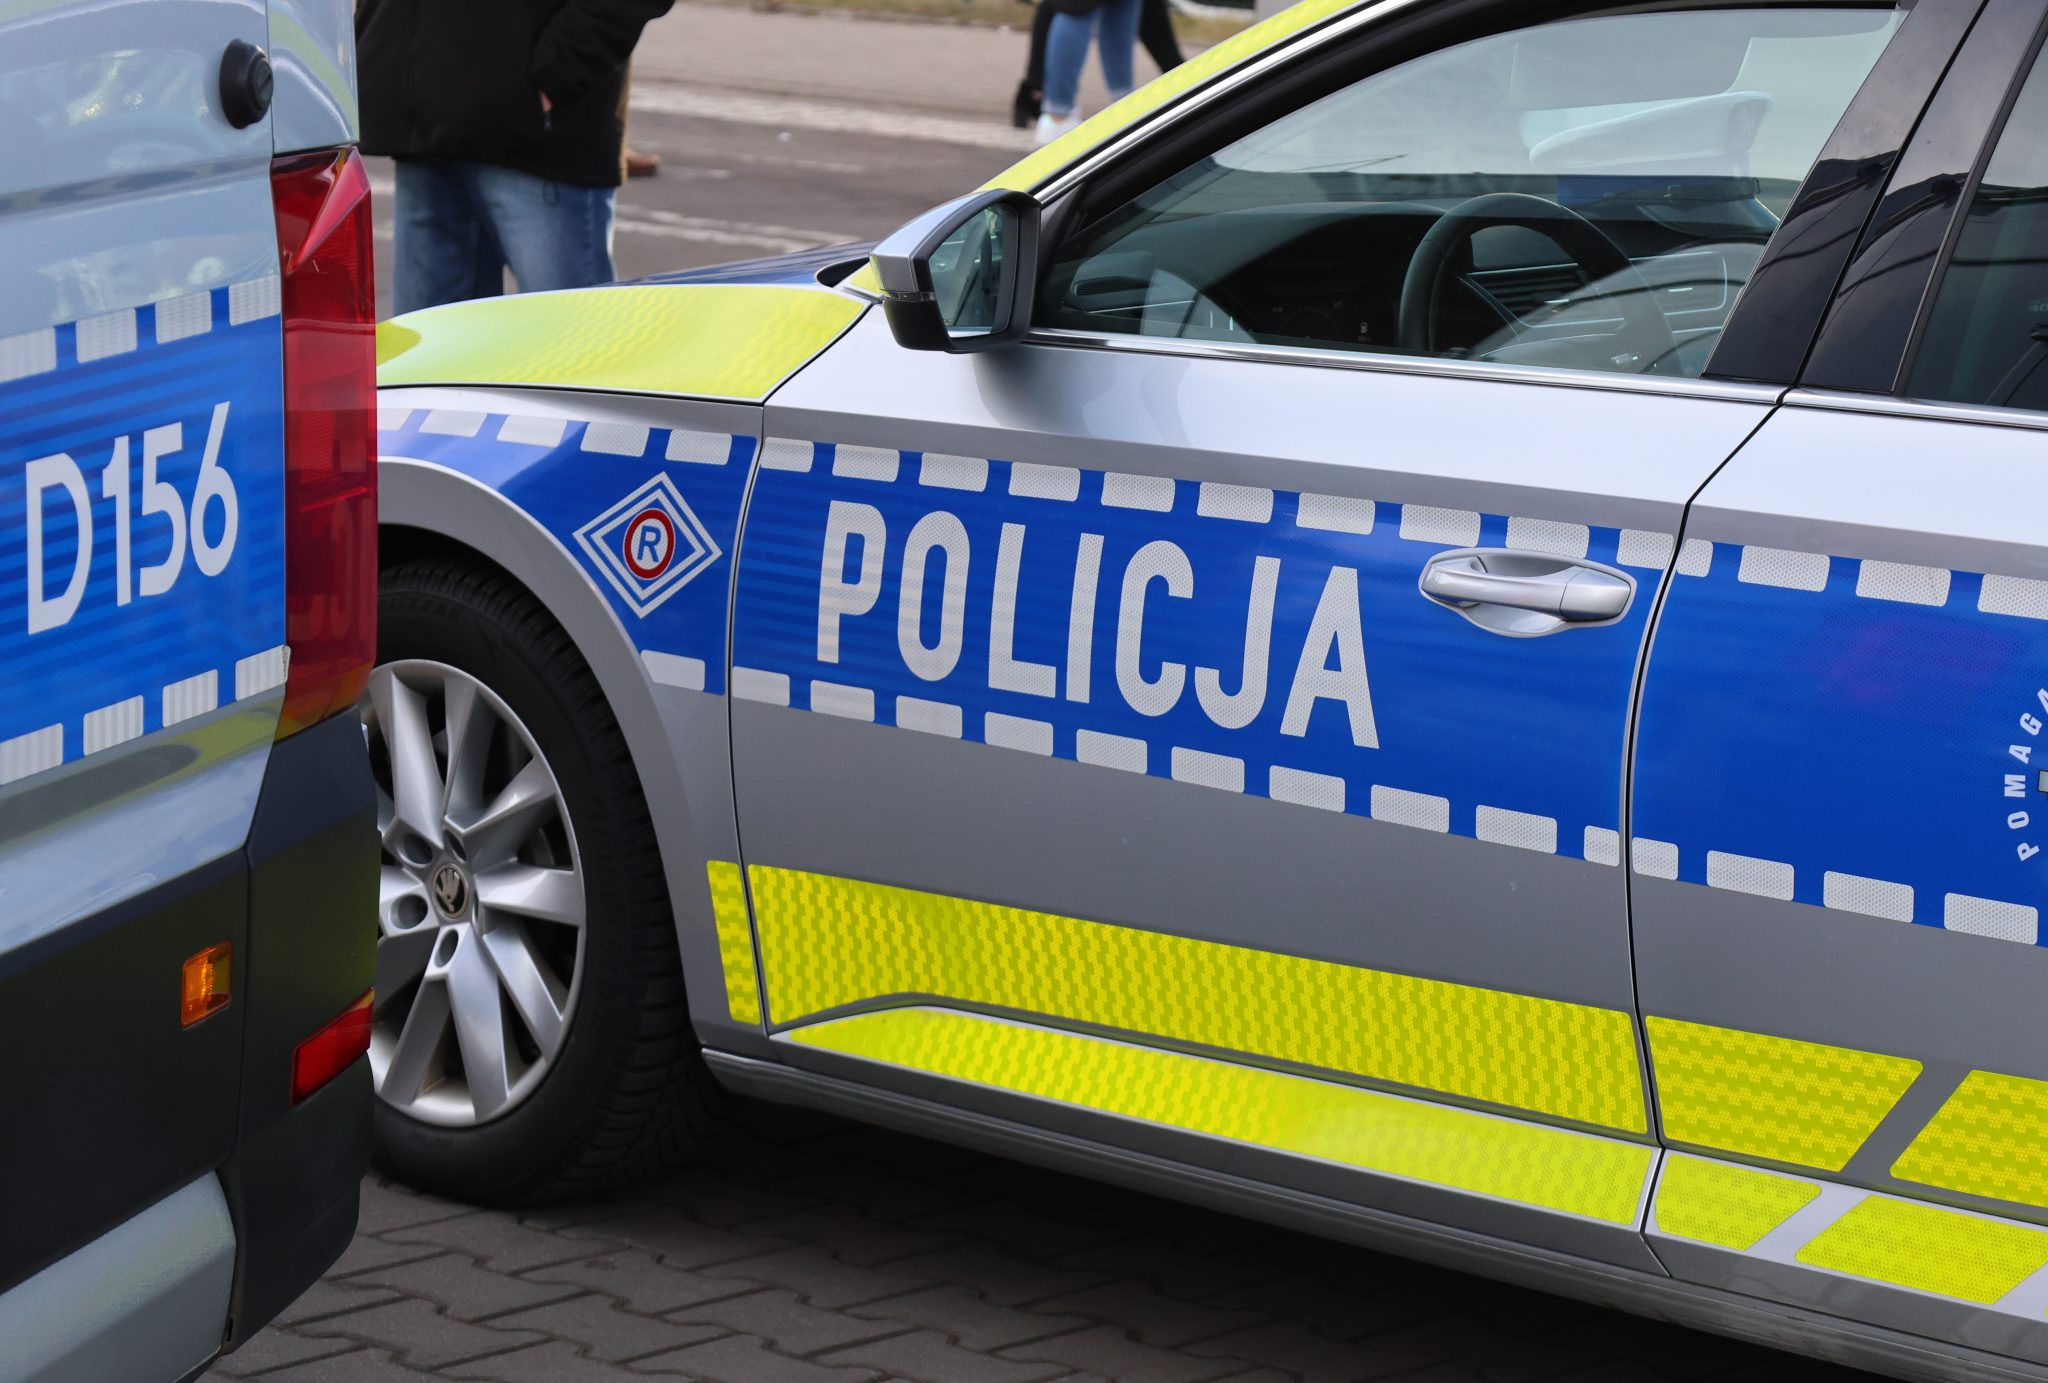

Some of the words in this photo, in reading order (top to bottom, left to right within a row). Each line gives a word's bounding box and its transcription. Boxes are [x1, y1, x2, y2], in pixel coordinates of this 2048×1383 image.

[26, 401, 239, 635] D156
[637, 525, 661, 563] R
[816, 500, 1380, 749] POLICJA
